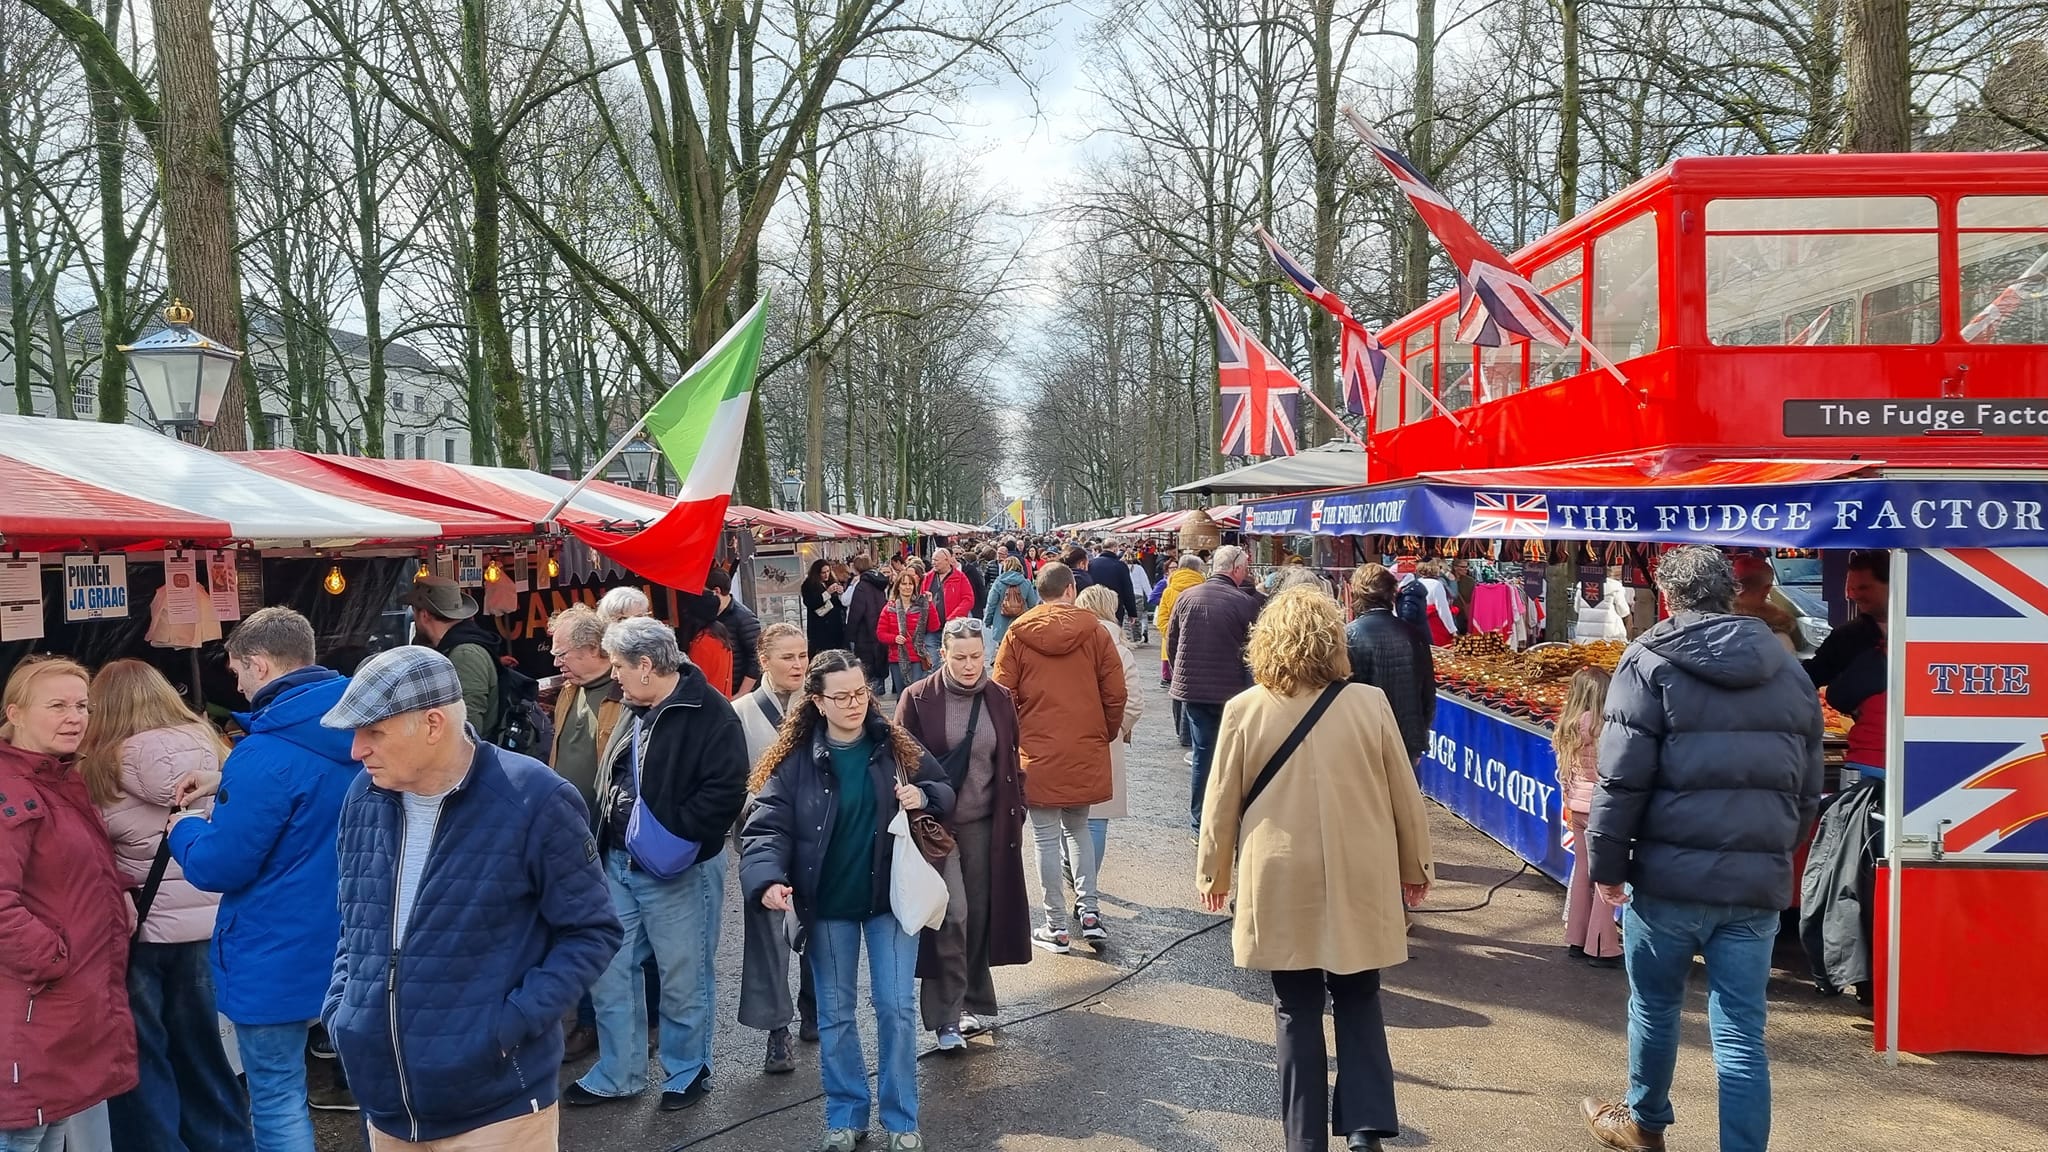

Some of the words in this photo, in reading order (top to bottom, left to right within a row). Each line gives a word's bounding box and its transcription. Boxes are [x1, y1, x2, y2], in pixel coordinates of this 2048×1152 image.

[1820, 405, 1871, 425] The
[1883, 404, 1965, 430] Fudge
[1557, 505, 1638, 531] THE
[1654, 502, 1812, 532] FUDGE
[1832, 500, 2045, 531] FACTOR
[68, 565, 110, 587] PINNEN
[69, 588, 85, 610] JA
[88, 586, 126, 609] GRAAG
[1928, 663, 2030, 695] THE
[1422, 730, 1457, 773] DGE
[1464, 746, 1556, 823] FACTORY
